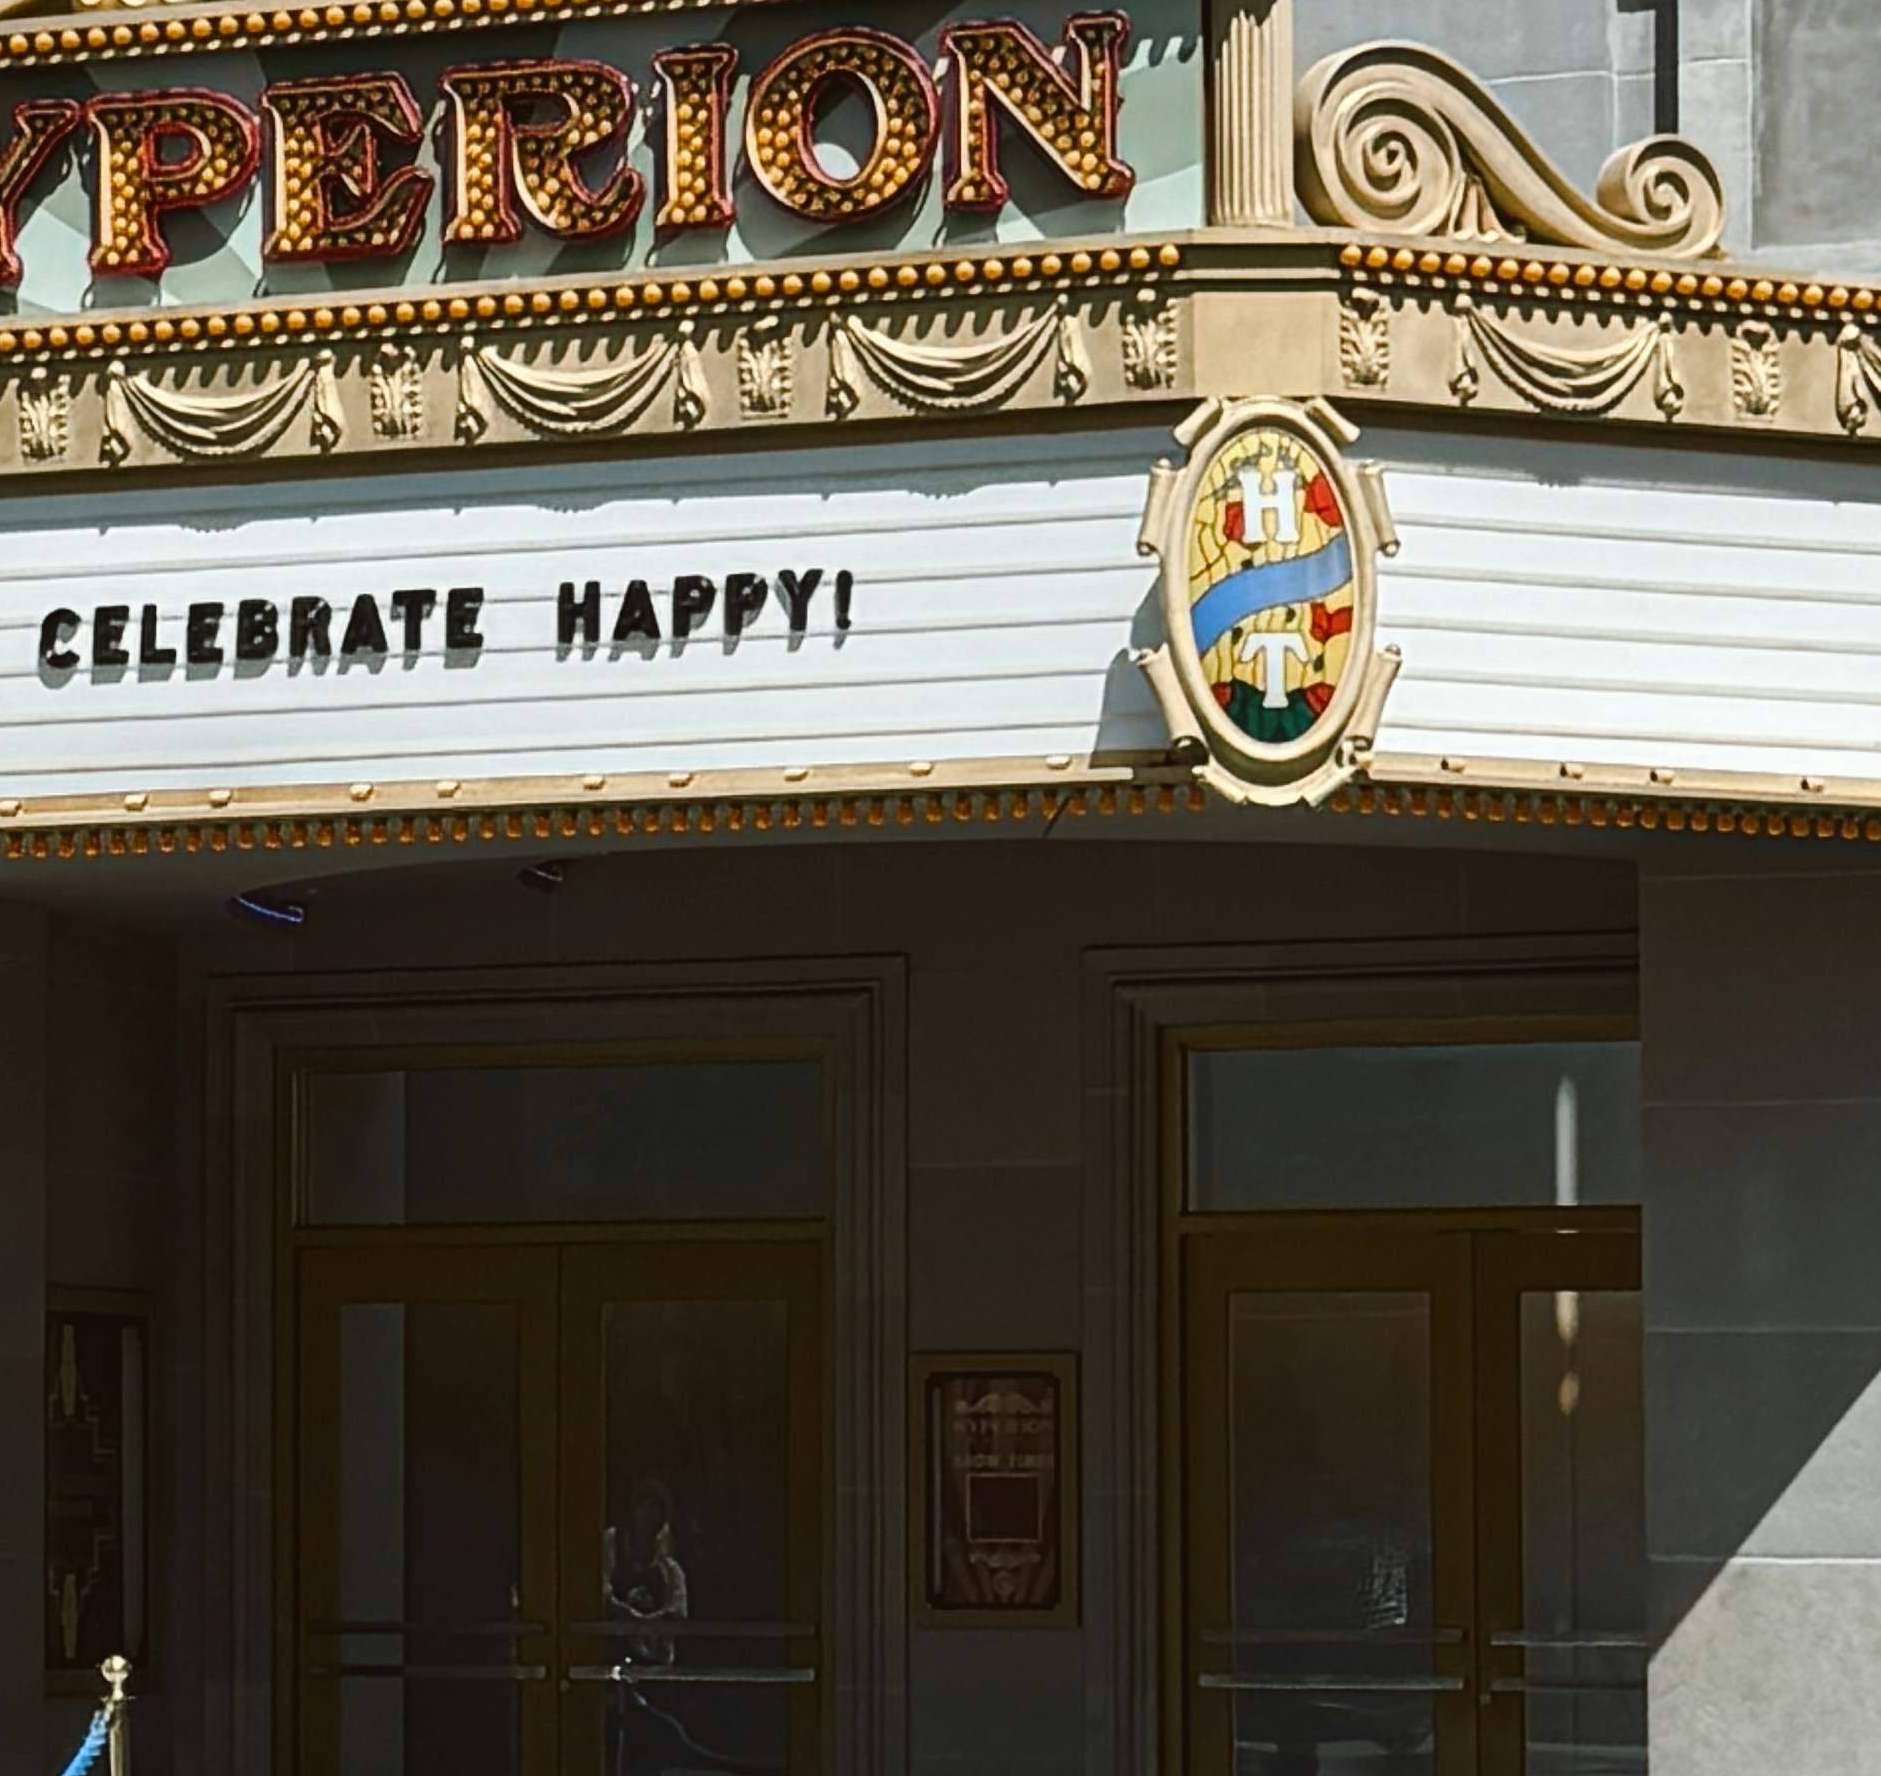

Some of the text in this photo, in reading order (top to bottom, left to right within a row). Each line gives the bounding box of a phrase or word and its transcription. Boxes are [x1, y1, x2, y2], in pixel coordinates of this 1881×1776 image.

[1237, 469, 1301, 545] H
[38, 569, 854, 669] CELEBRATE HAPPY!
[1240, 631, 1310, 709] T
